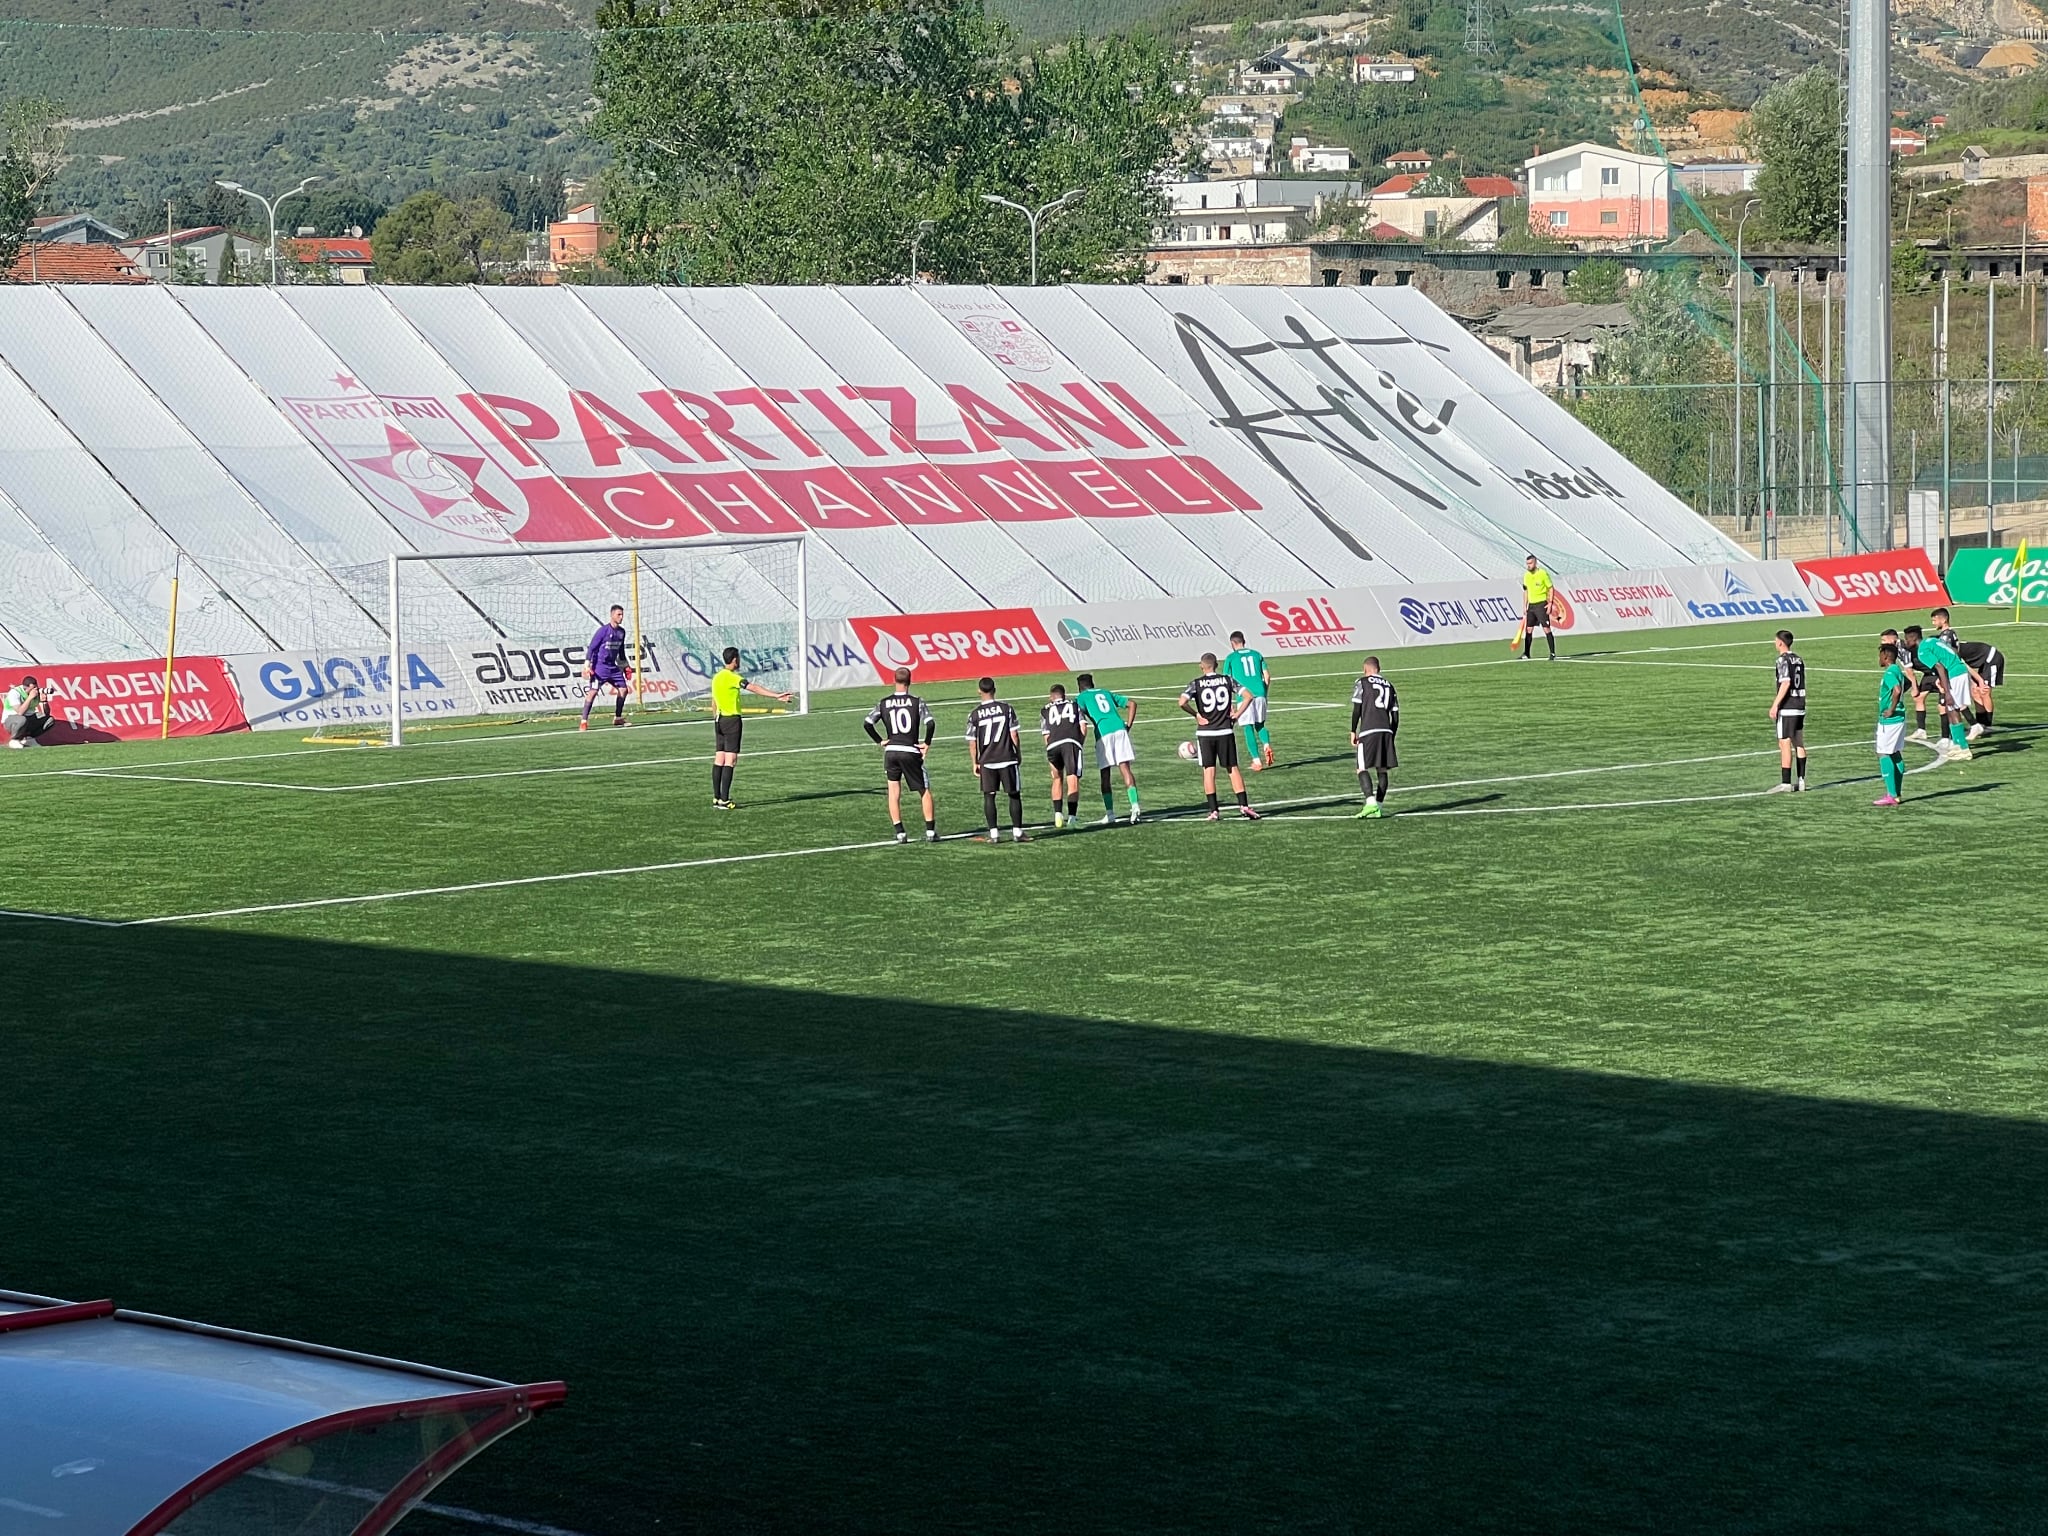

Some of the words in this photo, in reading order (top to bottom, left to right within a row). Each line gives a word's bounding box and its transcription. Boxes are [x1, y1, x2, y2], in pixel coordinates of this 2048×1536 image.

[456, 381, 1188, 467] PARTIZANI
[603, 469, 1212, 530] CHANNEL
[1568, 588, 1609, 604] LOTUS
[1609, 584, 1673, 601] ESSENTIAL
[1834, 567, 1939, 599] ESP&OIL
[1259, 597, 1343, 632] Sali
[1428, 601, 1473, 627] DEMI
[1472, 597, 1523, 624] HOTEL
[1616, 606, 1652, 618] BALM
[1688, 591, 1809, 619] tanushi
[910, 627, 1051, 662] ESP&OIL
[1091, 623, 1142, 644] Spitali
[1145, 621, 1216, 640] Amerikan
[1275, 634, 1351, 650] ELEKTRIK
[472, 635, 661, 684] abisset
[1241, 656, 1256, 677] 11
[46, 670, 209, 702] AKADEMIA
[259, 653, 445, 701] GJOKA
[485, 685, 569, 705] INTERNET
[885, 698, 912, 708] BALLA
[1094, 693, 1110, 713] 6
[1201, 686, 1229, 713] 99
[1372, 683, 1390, 709] 21
[63, 699, 212, 730] PARTIZANI
[279, 699, 456, 723] KONSTRUSION
[889, 708, 912, 734] 10
[978, 705, 1003, 717] HASA
[1049, 703, 1076, 725] 44
[978, 715, 1006, 745] 77
